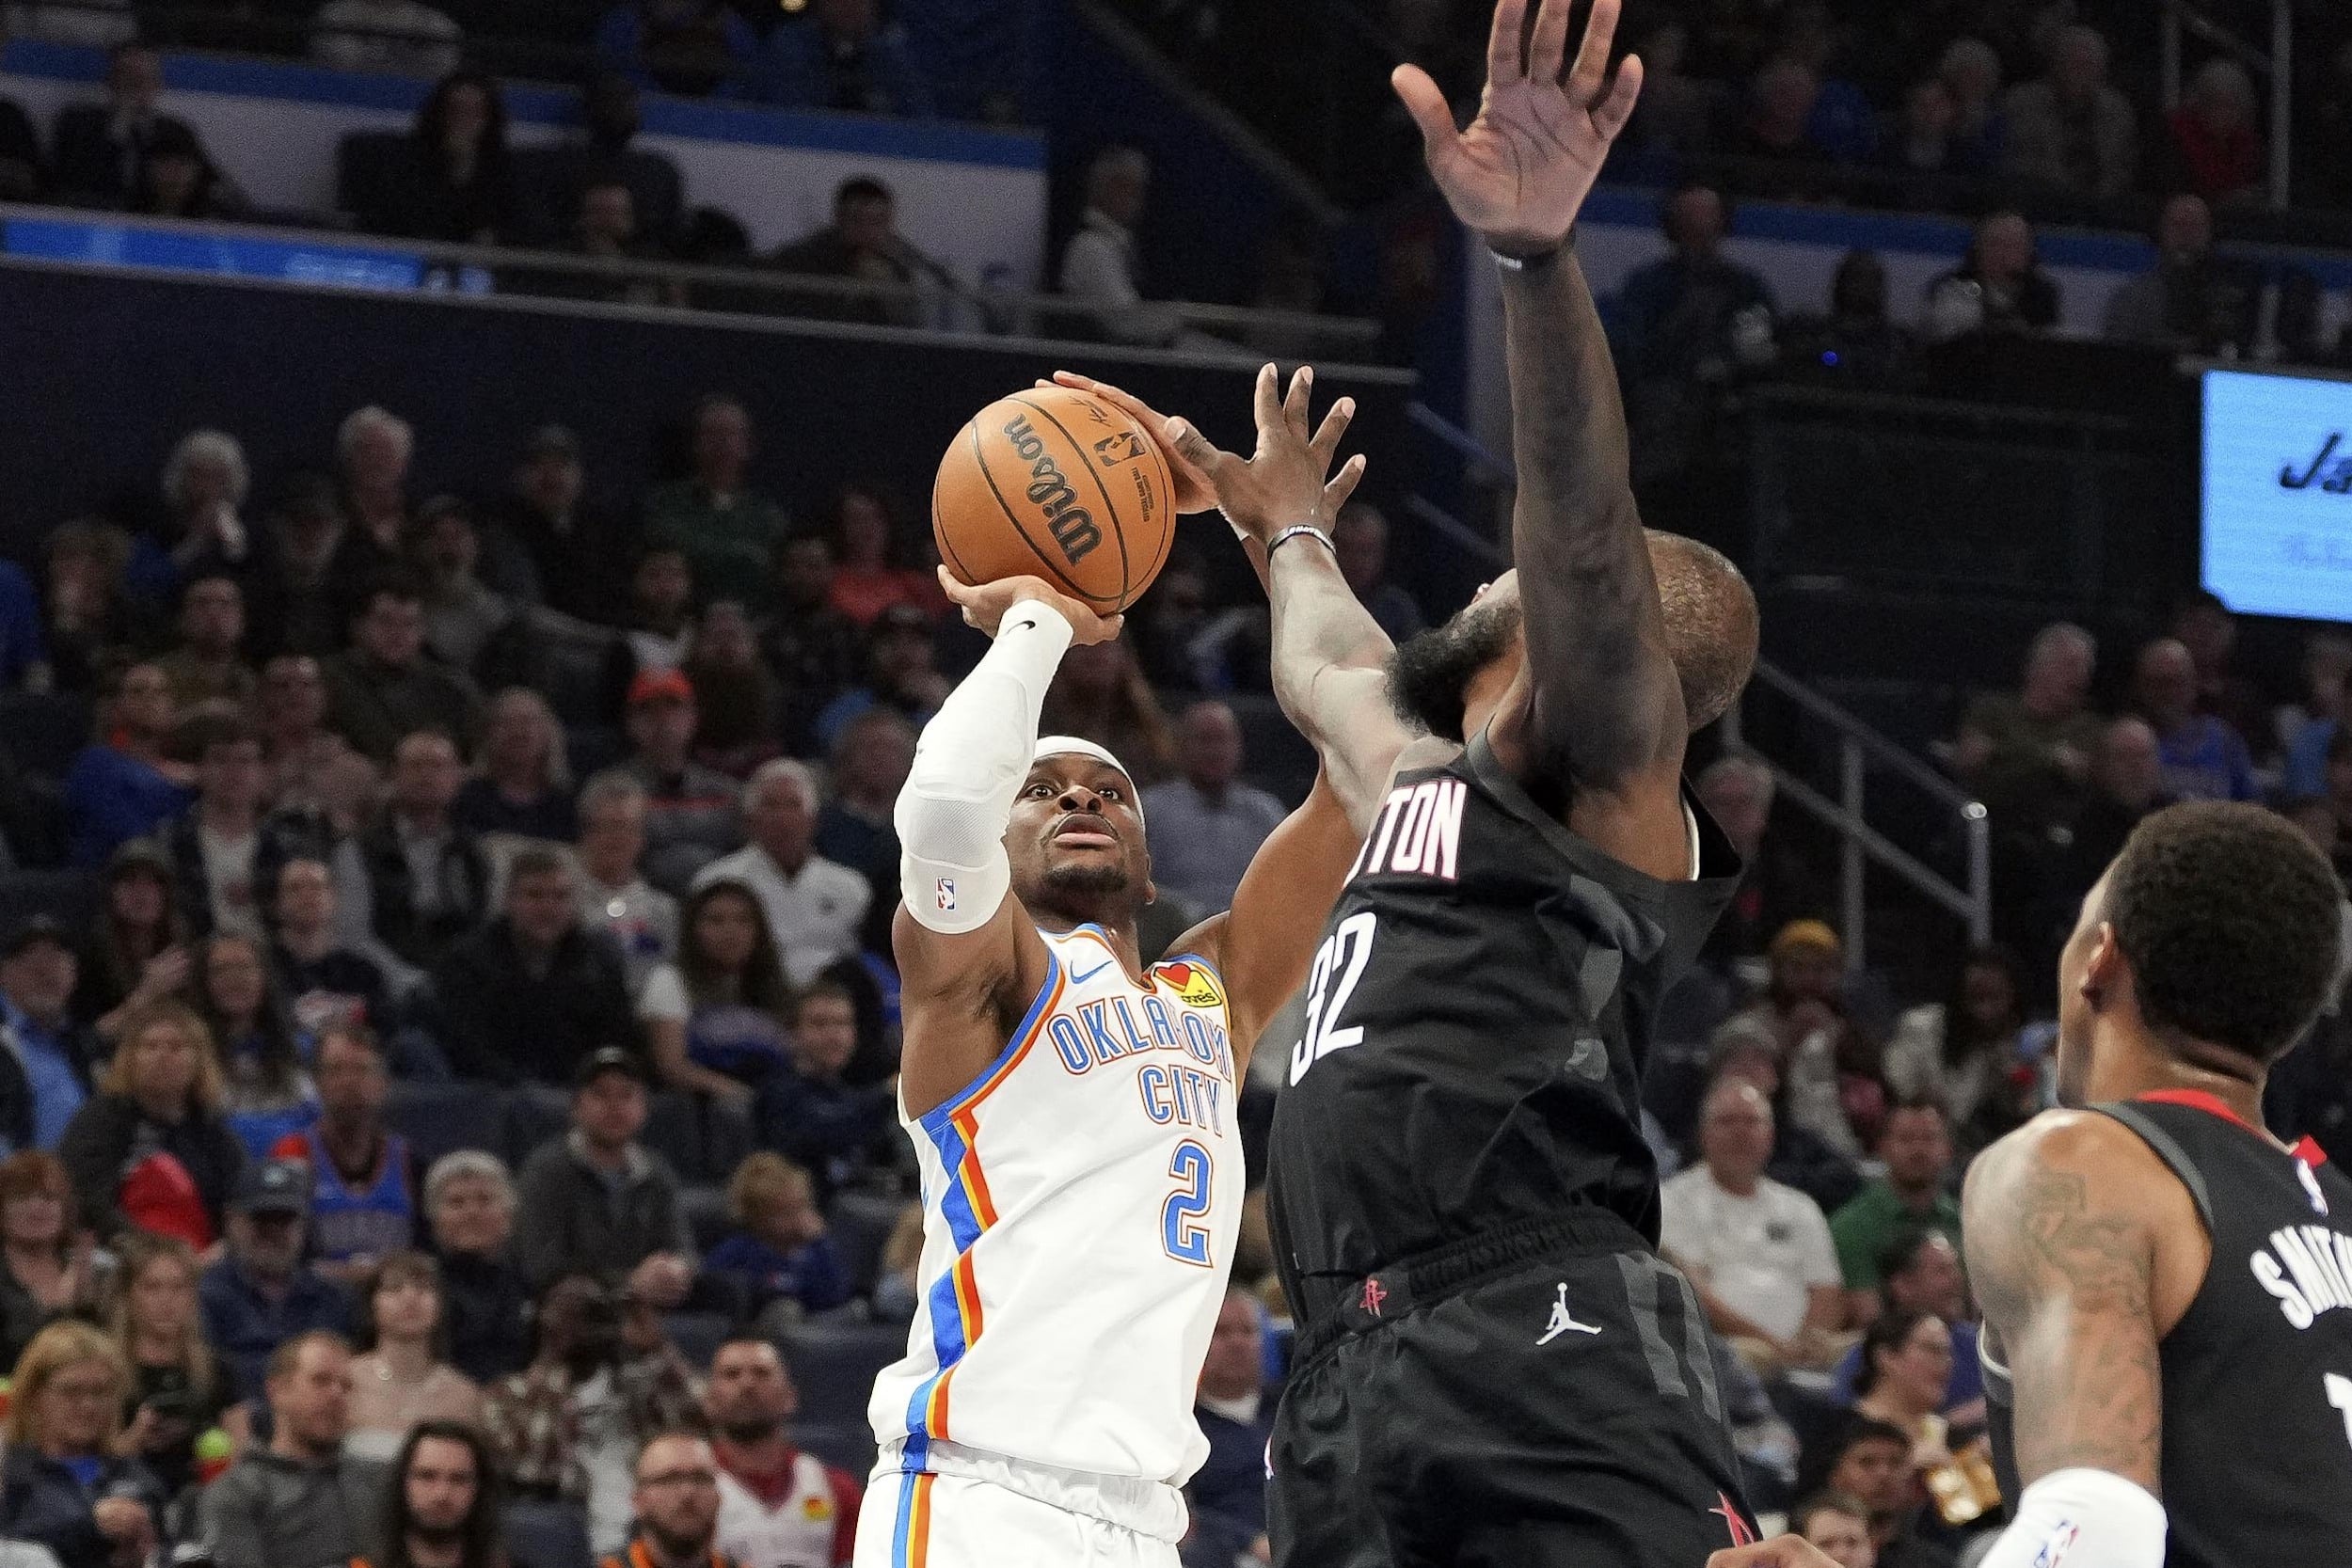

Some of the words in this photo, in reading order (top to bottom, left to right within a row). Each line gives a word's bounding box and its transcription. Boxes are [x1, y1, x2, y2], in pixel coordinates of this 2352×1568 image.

[1002, 413, 1103, 567] Wilson
[1343, 780, 1467, 889] TON
[1047, 994, 1231, 1083] OKLAOM
[1181, 989, 1216, 1004] ove's
[1290, 911, 1377, 1087] 32
[1138, 1064, 1222, 1138] CITY
[1160, 1138, 1214, 1269] 2
